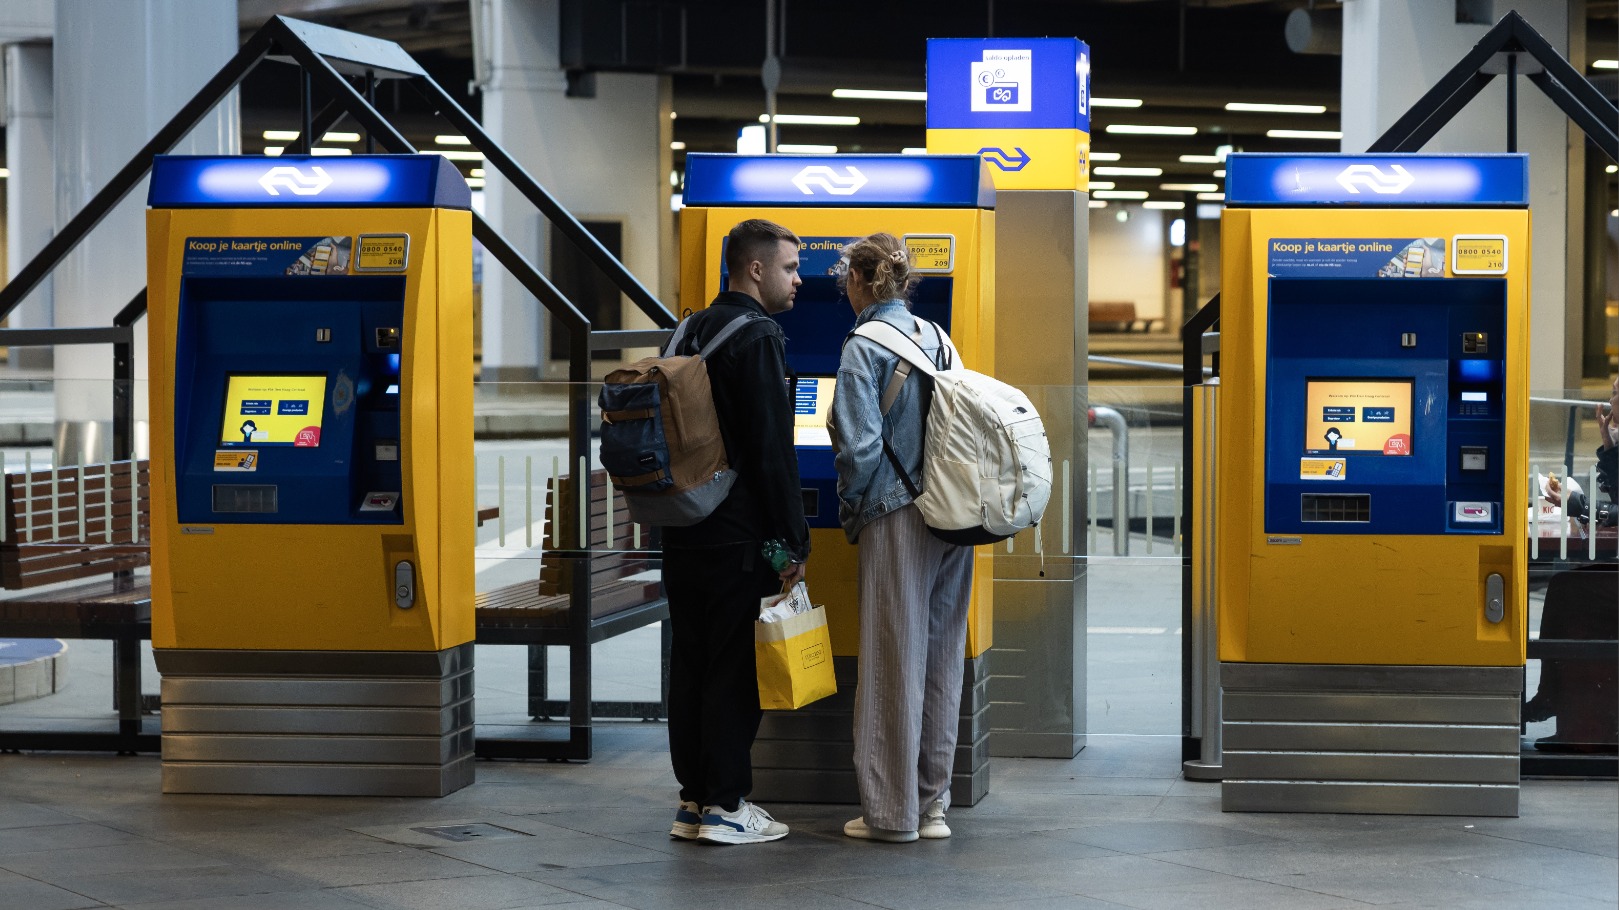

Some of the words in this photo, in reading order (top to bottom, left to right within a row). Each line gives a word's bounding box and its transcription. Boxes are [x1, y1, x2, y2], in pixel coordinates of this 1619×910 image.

[189, 240, 217, 253] Koop
[218, 240, 229, 253] je
[231, 240, 268, 253] kaartje
[269, 240, 302, 251] online
[809, 240, 843, 250] online
[1273, 242, 1302, 254] Koop
[1304, 242, 1315, 254] je
[1317, 242, 1356, 254] kaartje
[1358, 242, 1393, 252] online
